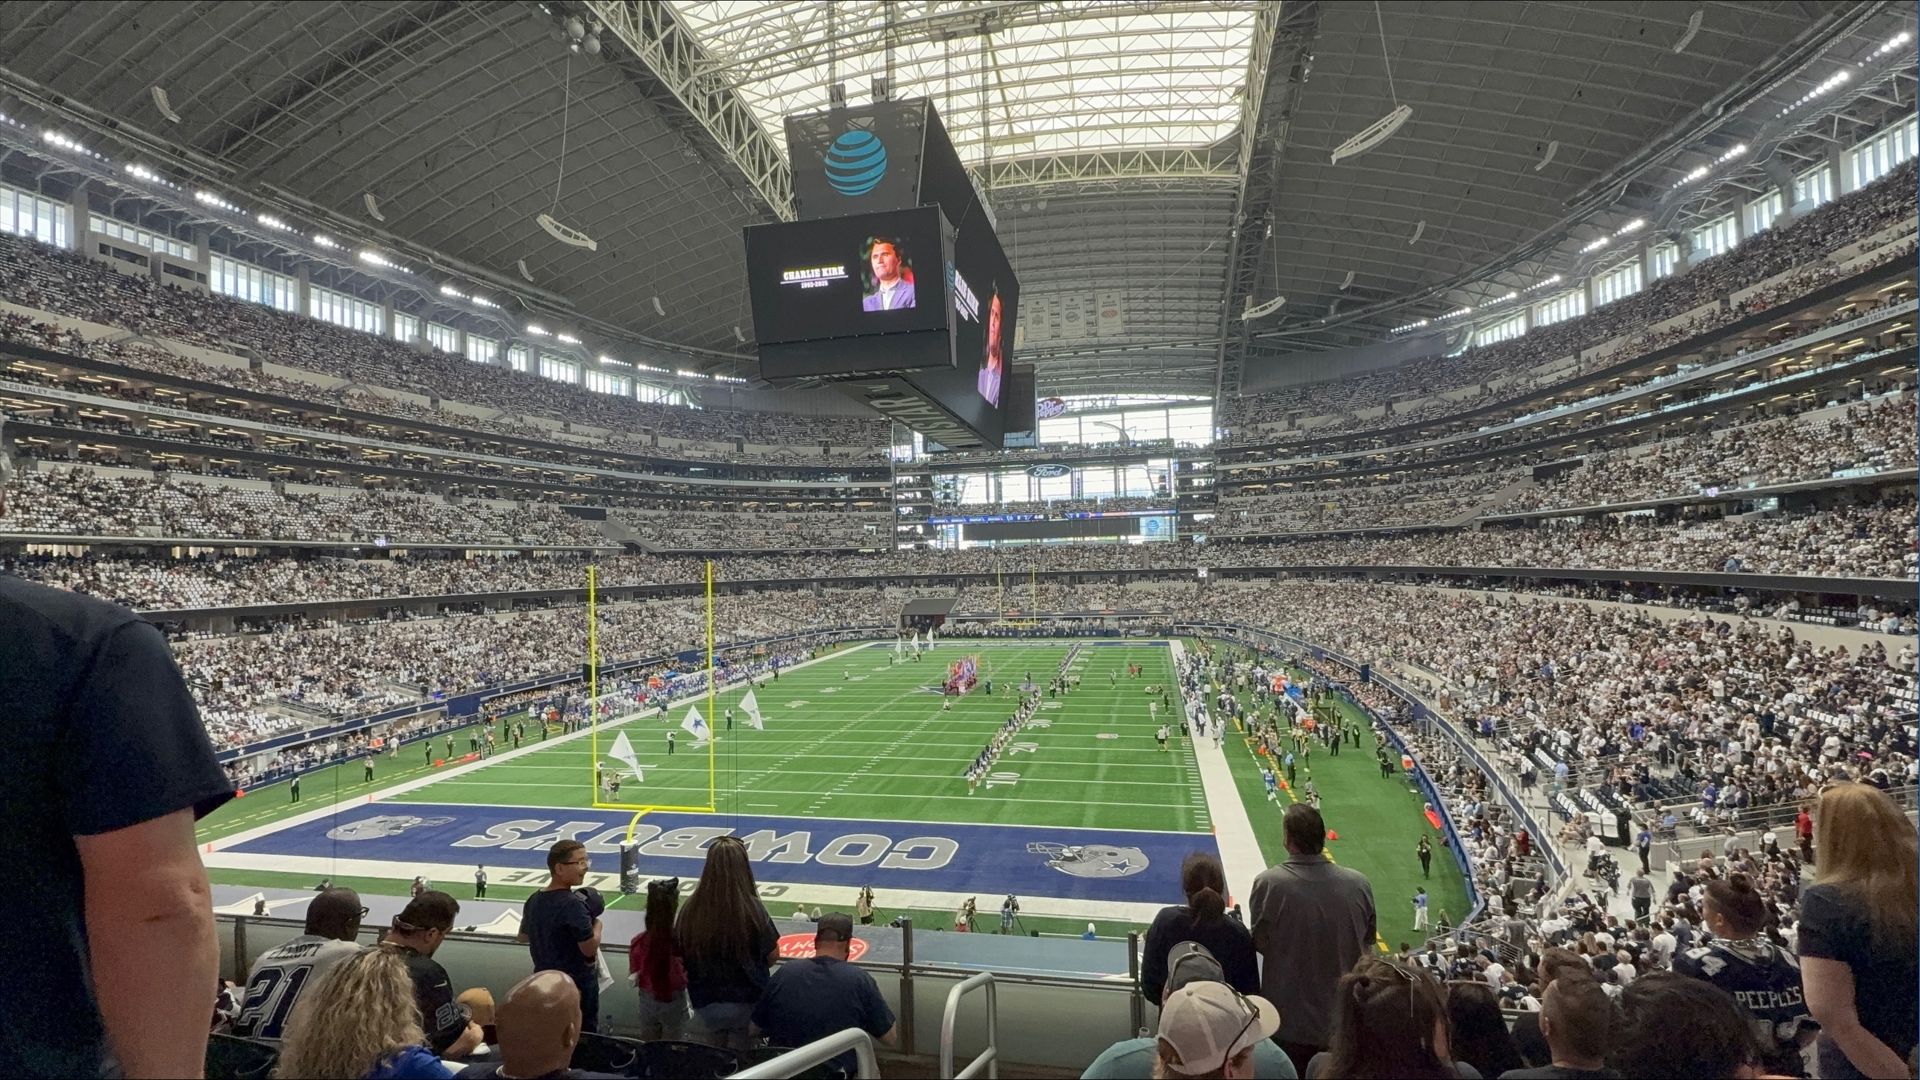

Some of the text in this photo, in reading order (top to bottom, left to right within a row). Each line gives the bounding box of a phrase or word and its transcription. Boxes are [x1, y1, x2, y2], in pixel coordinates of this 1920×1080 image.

[783, 266, 845, 281] CHARLIE KIRK
[21, 385, 48, 395] HALEY
[147, 406, 175, 416] MICHAEL
[1033, 466, 1063, 477] Ford
[451, 819, 960, 870] COWBOYS
[500, 870, 610, 888] LVE
[237, 964, 314, 1042] 21
[1734, 985, 1803, 1009] PEEPLES
